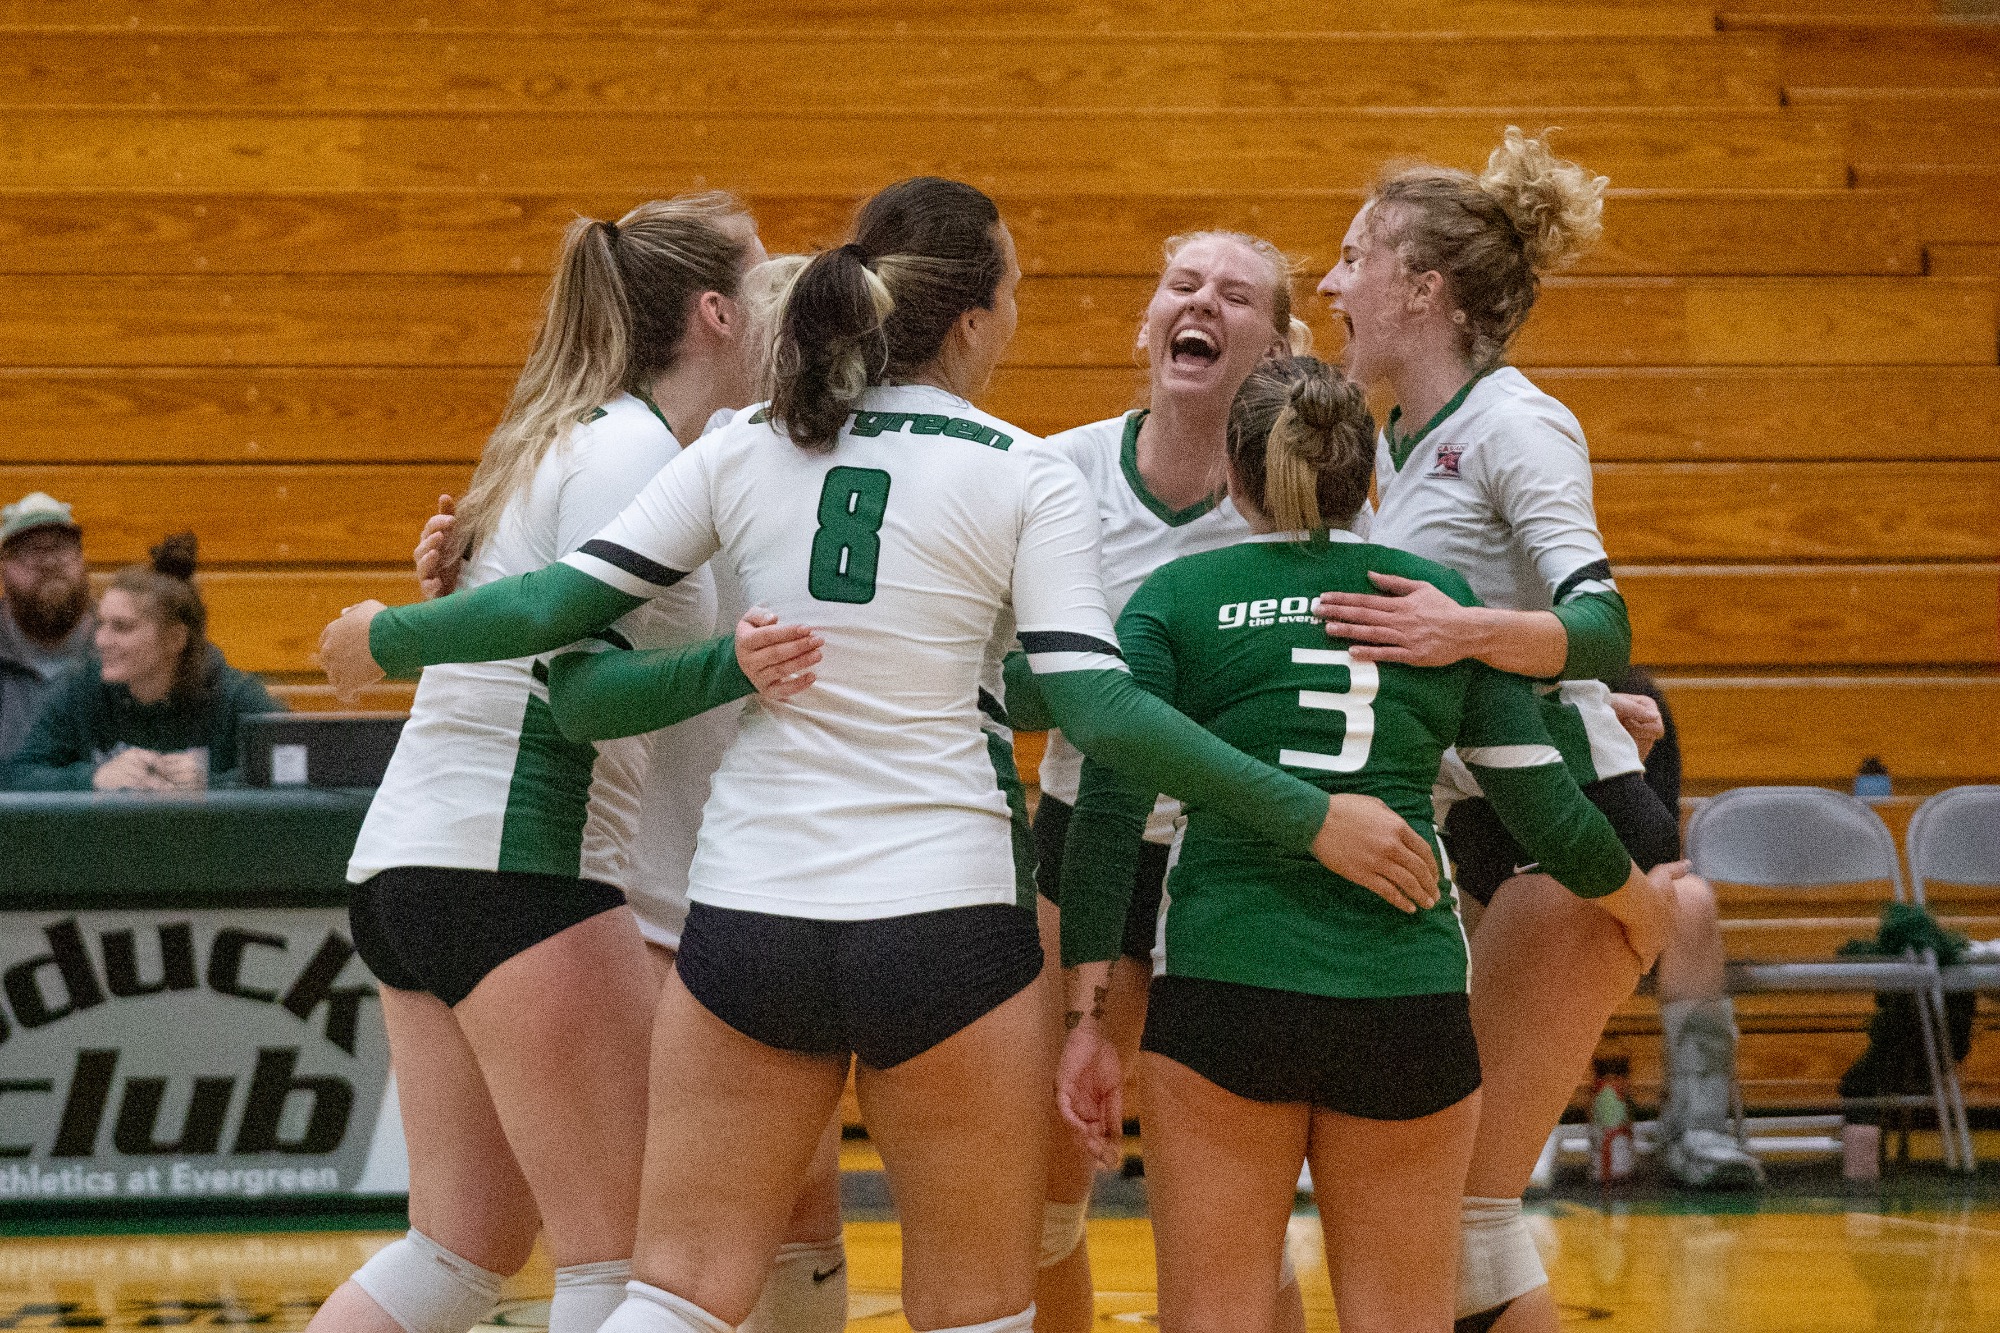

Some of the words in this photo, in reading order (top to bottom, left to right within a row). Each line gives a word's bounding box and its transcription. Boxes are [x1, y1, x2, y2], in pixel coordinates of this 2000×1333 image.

[748, 409, 1014, 451] green
[808, 465, 892, 604] 8
[1248, 617, 1275, 627] the
[1279, 647, 1380, 772] 3
[0, 918, 378, 1056] duck
[128, 1169, 160, 1192] at
[172, 1162, 338, 1195] Evergreen
